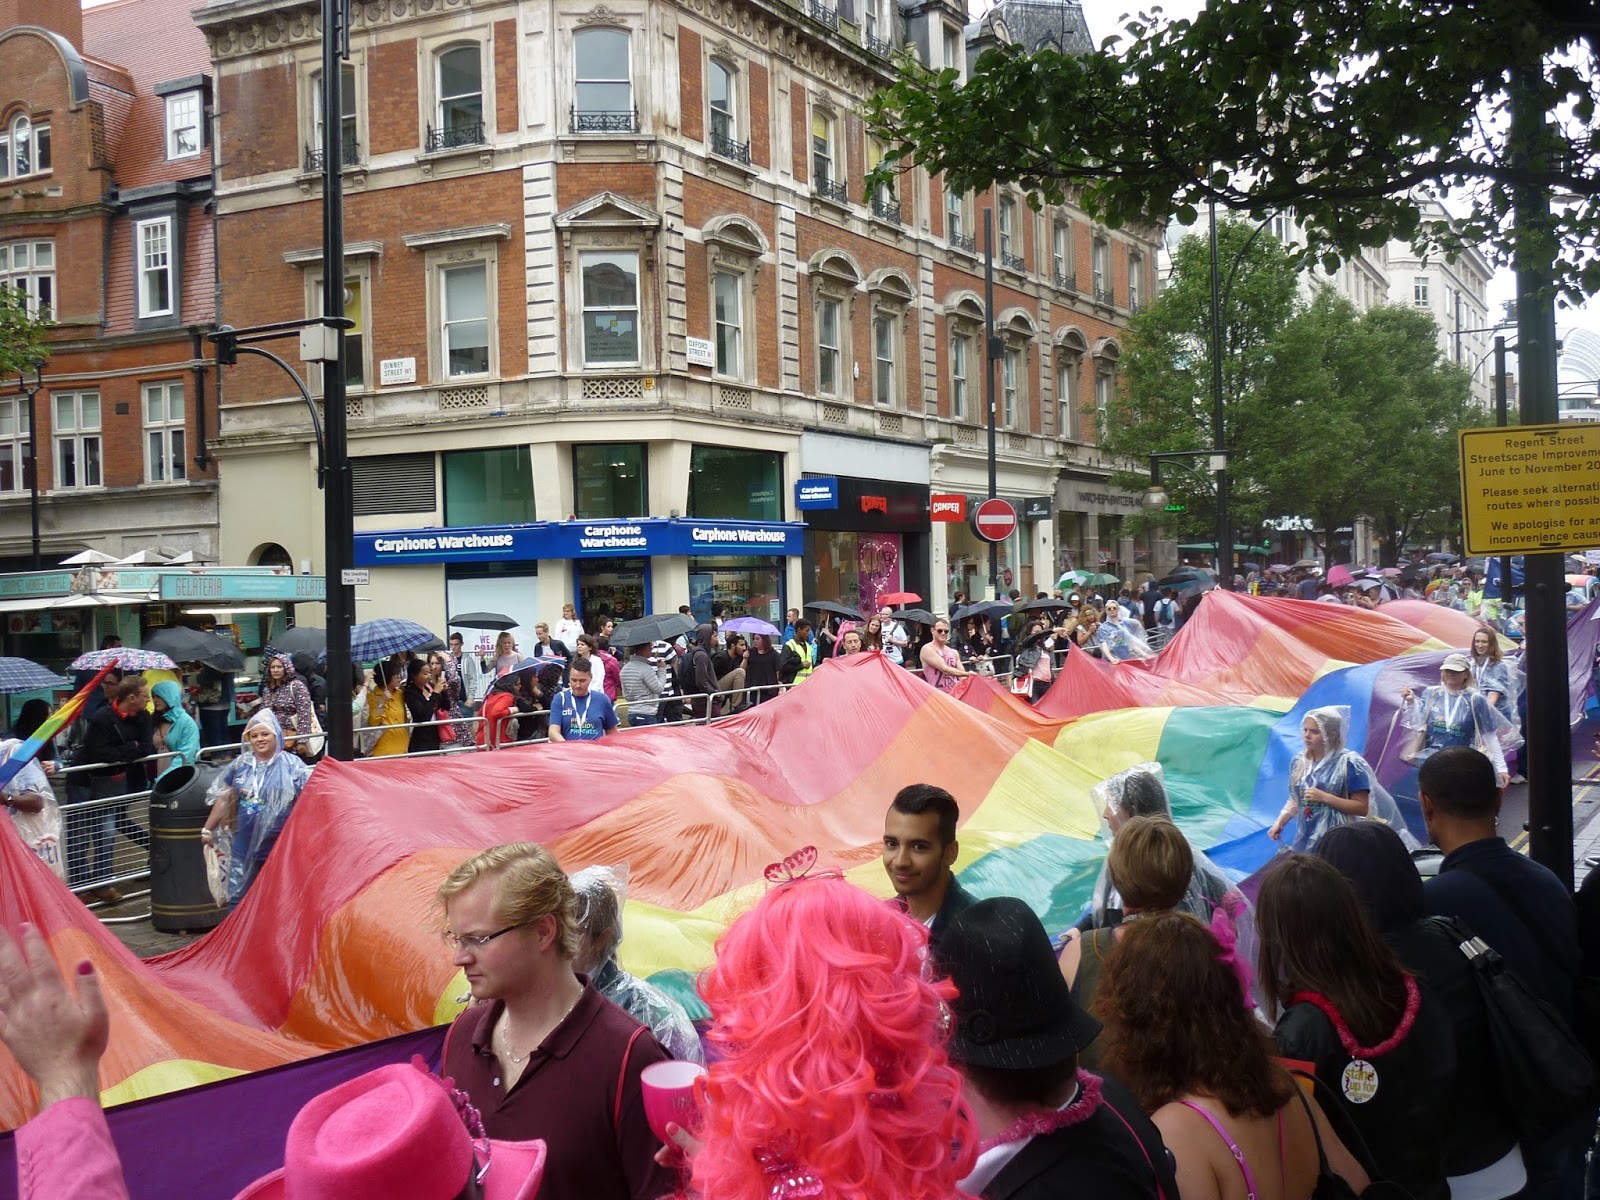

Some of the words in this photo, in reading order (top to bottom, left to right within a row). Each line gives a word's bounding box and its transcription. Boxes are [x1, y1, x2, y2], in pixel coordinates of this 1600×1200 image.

[688, 340, 708, 349] OXFORD
[688, 348, 706, 357] STREET
[383, 361, 403, 369] BINNEY
[383, 369, 403, 377] STREET
[1505, 438, 1545, 449] Regent
[1549, 435, 1584, 446] Street
[1470, 453, 1538, 463] Streetscape
[1479, 468, 1505, 477] June
[1510, 466, 1521, 474] to
[1525, 462, 1582, 474] November
[1586, 460, 1600, 470] 20
[800, 486, 829, 495] Carphone
[1483, 488, 1519, 497] Please
[1523, 486, 1548, 495] seek
[1552, 482, 1600, 494] alternati
[799, 492, 832, 500] Warehouse
[933, 502, 959, 514] CAMPER
[1487, 500, 1523, 511] routes
[1527, 498, 1561, 508] where
[1491, 521, 1509, 531] We
[1512, 519, 1565, 531] apologise
[1569, 517, 1584, 526] for
[585, 526, 641, 538] Carphone
[692, 527, 738, 543] Carphone
[738, 529, 786, 543] Warehouse
[1489, 532, 1569, 545] inconvenience
[1573, 530, 1600, 540] caus
[375, 536, 437, 553] Carphone
[436, 533, 514, 549] Warehouse
[580, 536, 647, 548] Warehouse
[176, 577, 222, 597] GELATERIA
[480, 635, 491, 643] WE
[1345, 1068, 1375, 1081] stand
[1350, 1082, 1361, 1093] up
[1363, 1081, 1376, 1093] for
